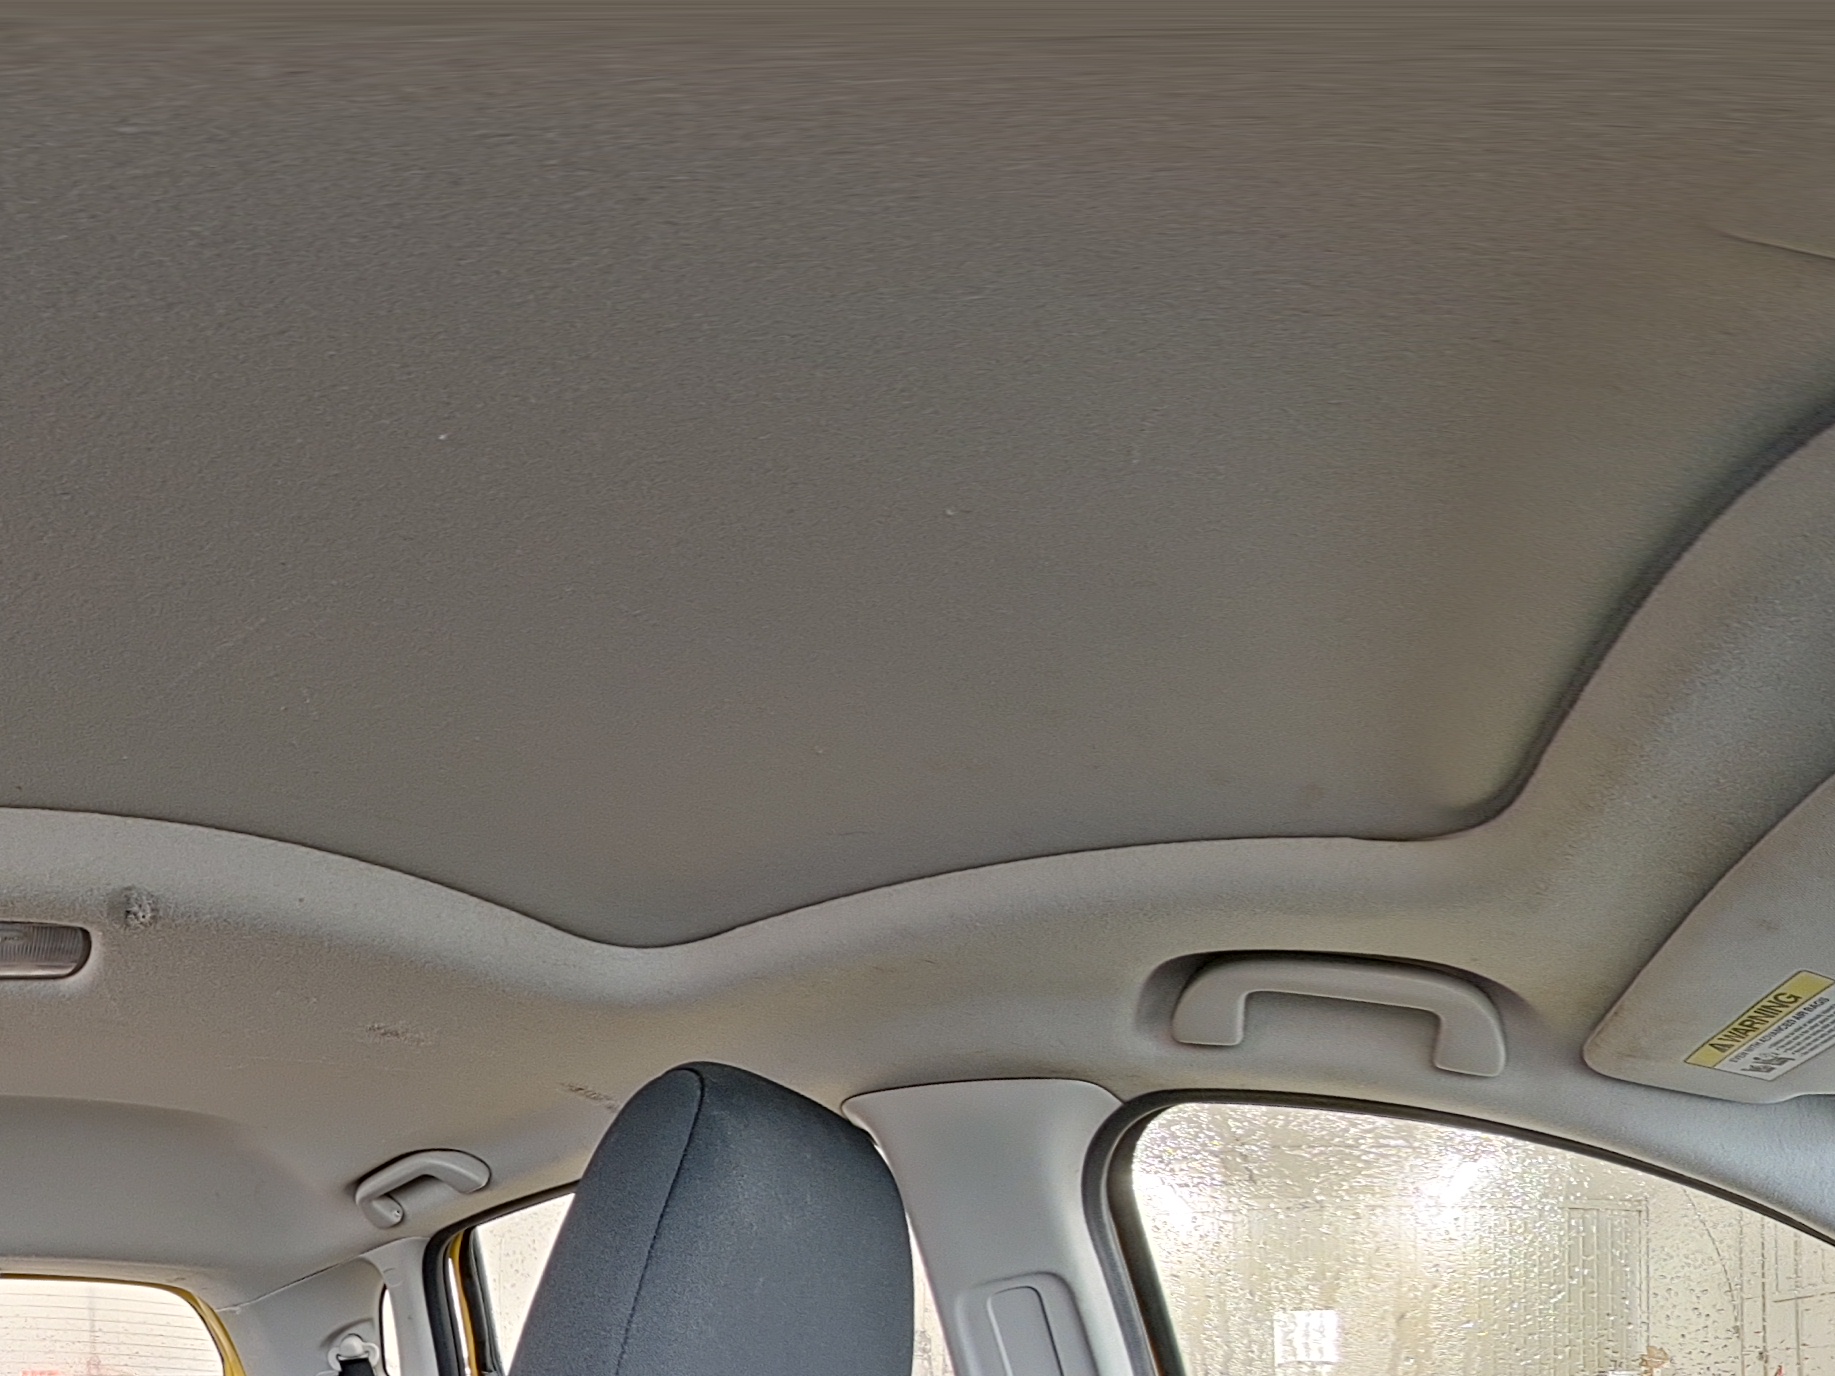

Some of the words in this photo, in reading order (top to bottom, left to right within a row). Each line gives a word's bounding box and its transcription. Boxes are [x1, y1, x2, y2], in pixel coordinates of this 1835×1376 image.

[1721, 992, 1801, 1047] WARNING
[1759, 1019, 1796, 1043] ADVANCED
[1793, 1010, 1809, 1021] AIR
